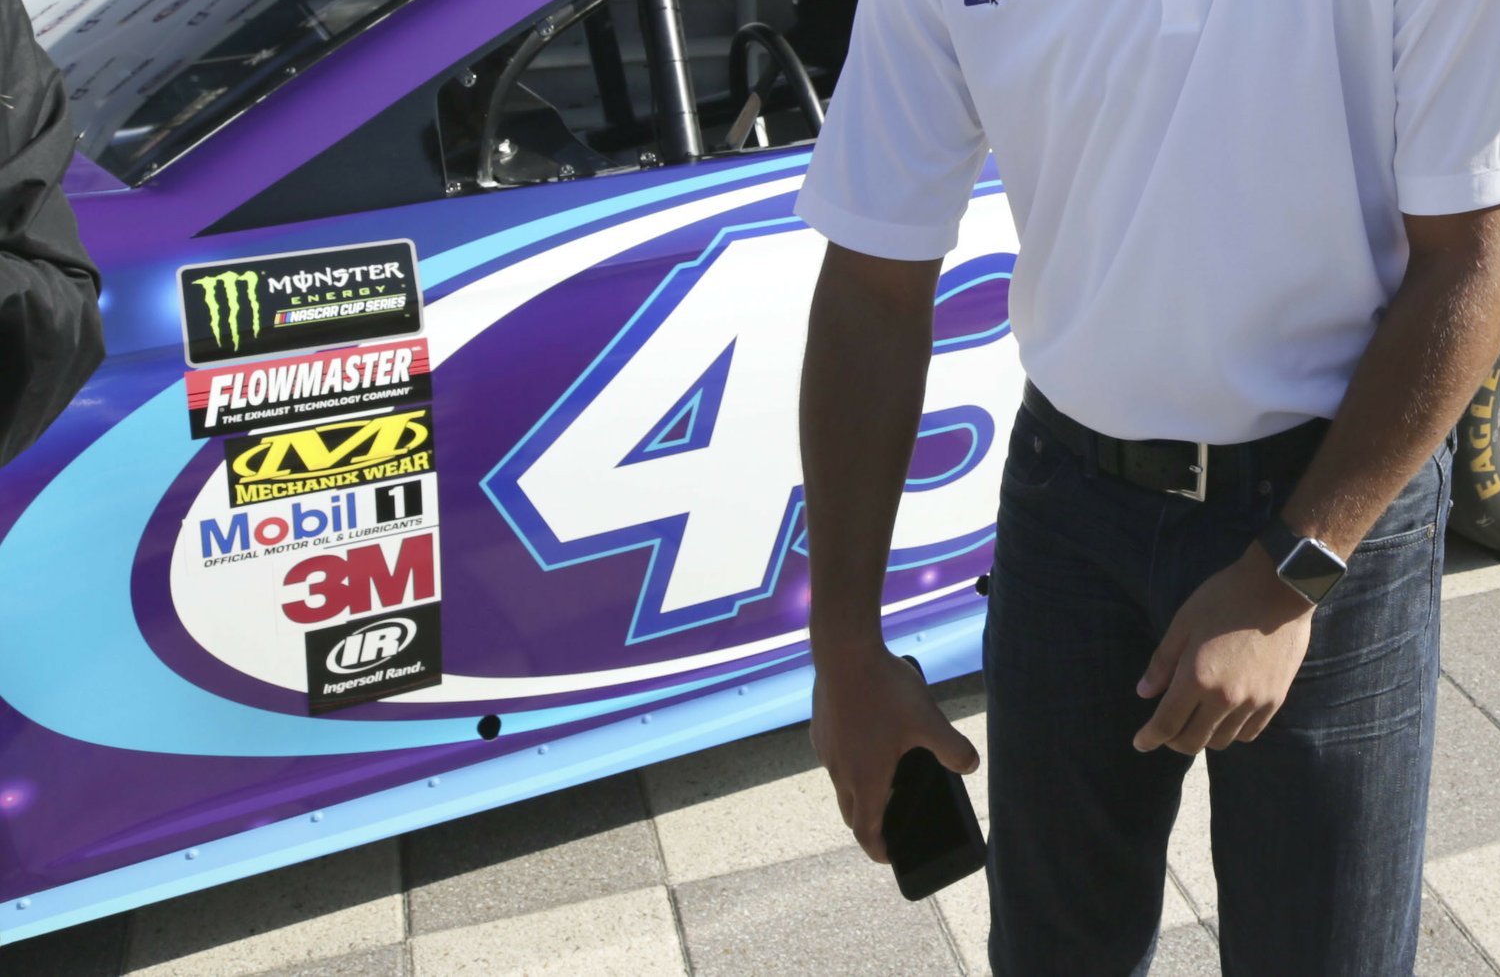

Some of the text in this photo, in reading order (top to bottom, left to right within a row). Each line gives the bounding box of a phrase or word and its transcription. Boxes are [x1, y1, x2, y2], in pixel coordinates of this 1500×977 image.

[268, 262, 404, 294] MONSTER
[291, 285, 386, 305] ENERGY
[291, 296, 406, 322] NASCAR CUP SERIES
[205, 348, 413, 428] FLOWMASTER
[222, 386, 411, 424] THE EXHAUST TECHNOLOGY COMPANY
[235, 451, 430, 504] MECHANIX WEAR
[200, 492, 357, 558] Mobil
[204, 518, 423, 568] OFFICIAL MOTOR OIL & LUBRICANTS
[282, 533, 435, 624] 3M
[341, 626, 402, 667] IR
[323, 662, 421, 695] Ingersoll Rand
